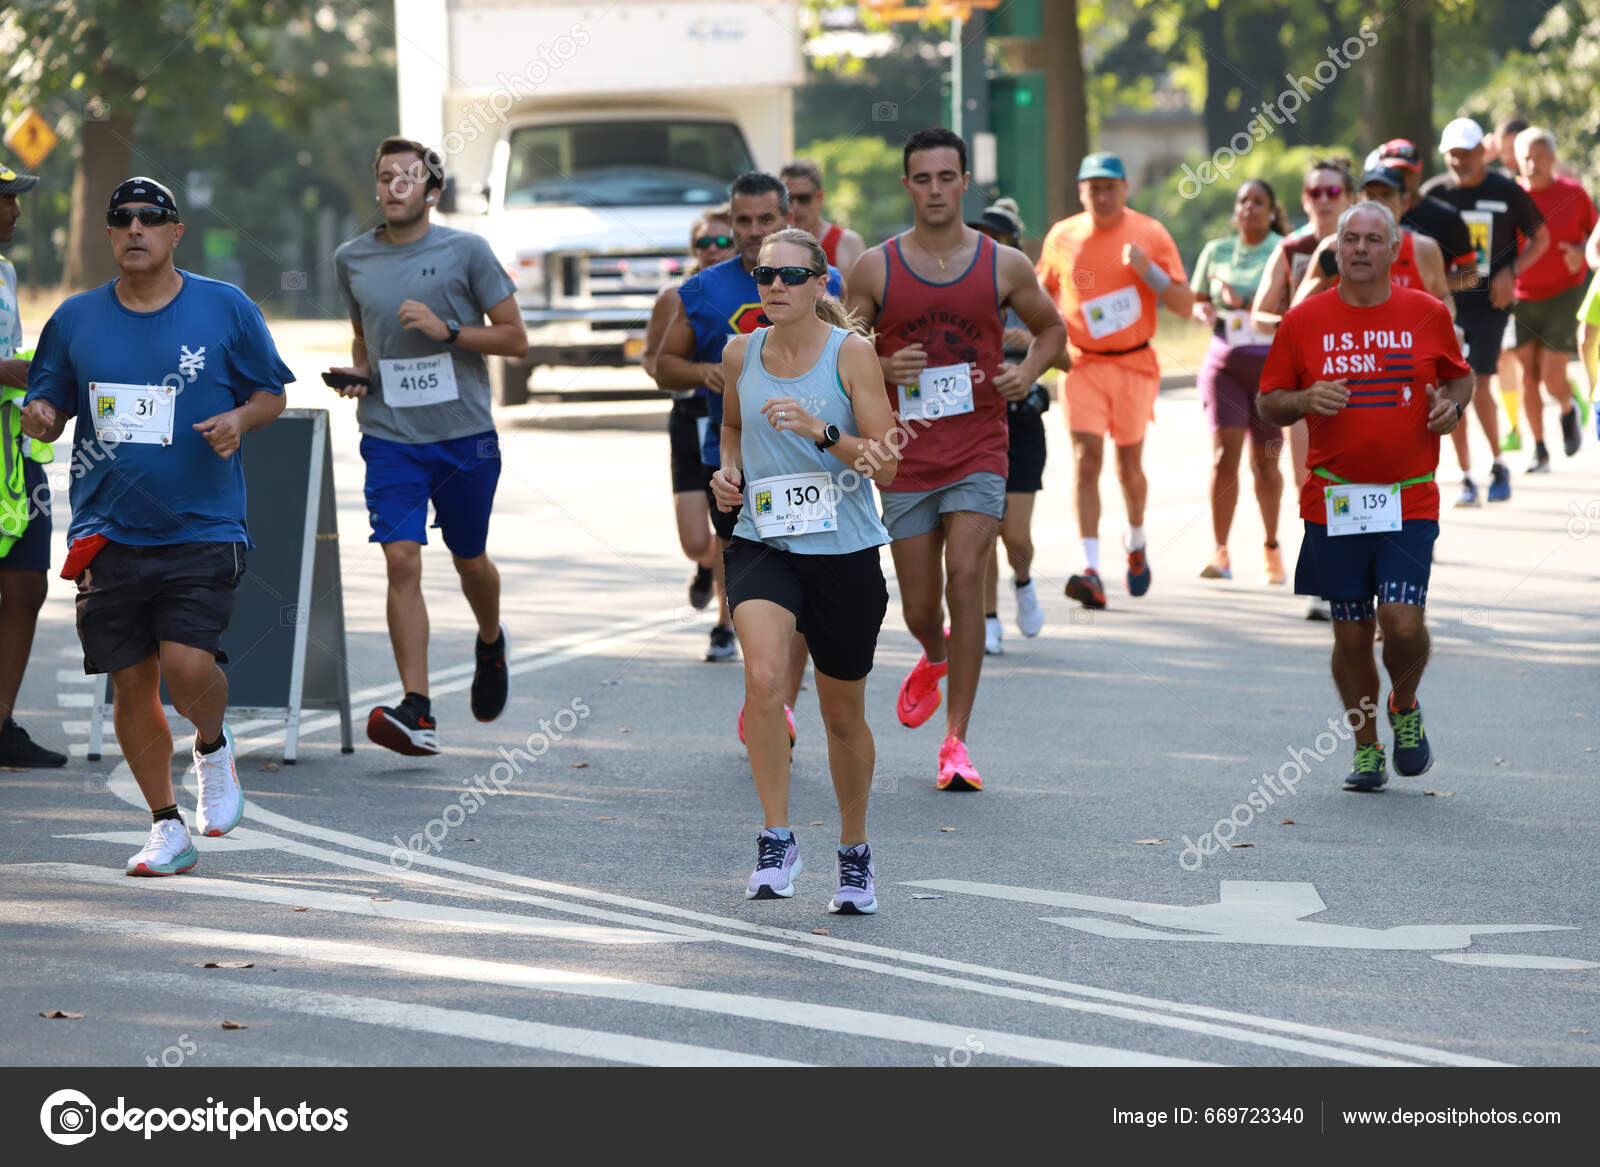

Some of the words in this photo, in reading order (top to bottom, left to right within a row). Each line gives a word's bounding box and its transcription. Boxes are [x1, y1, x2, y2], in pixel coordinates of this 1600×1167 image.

[1323, 333, 1359, 352] U.S.
[1363, 330, 1413, 349] POLO
[1322, 354, 1383, 375] ASSN.
[400, 373, 438, 391] 4165
[933, 376, 957, 393] 127
[136, 398, 154, 416] 31
[785, 485, 820, 506] 130
[1362, 494, 1388, 510] 139
